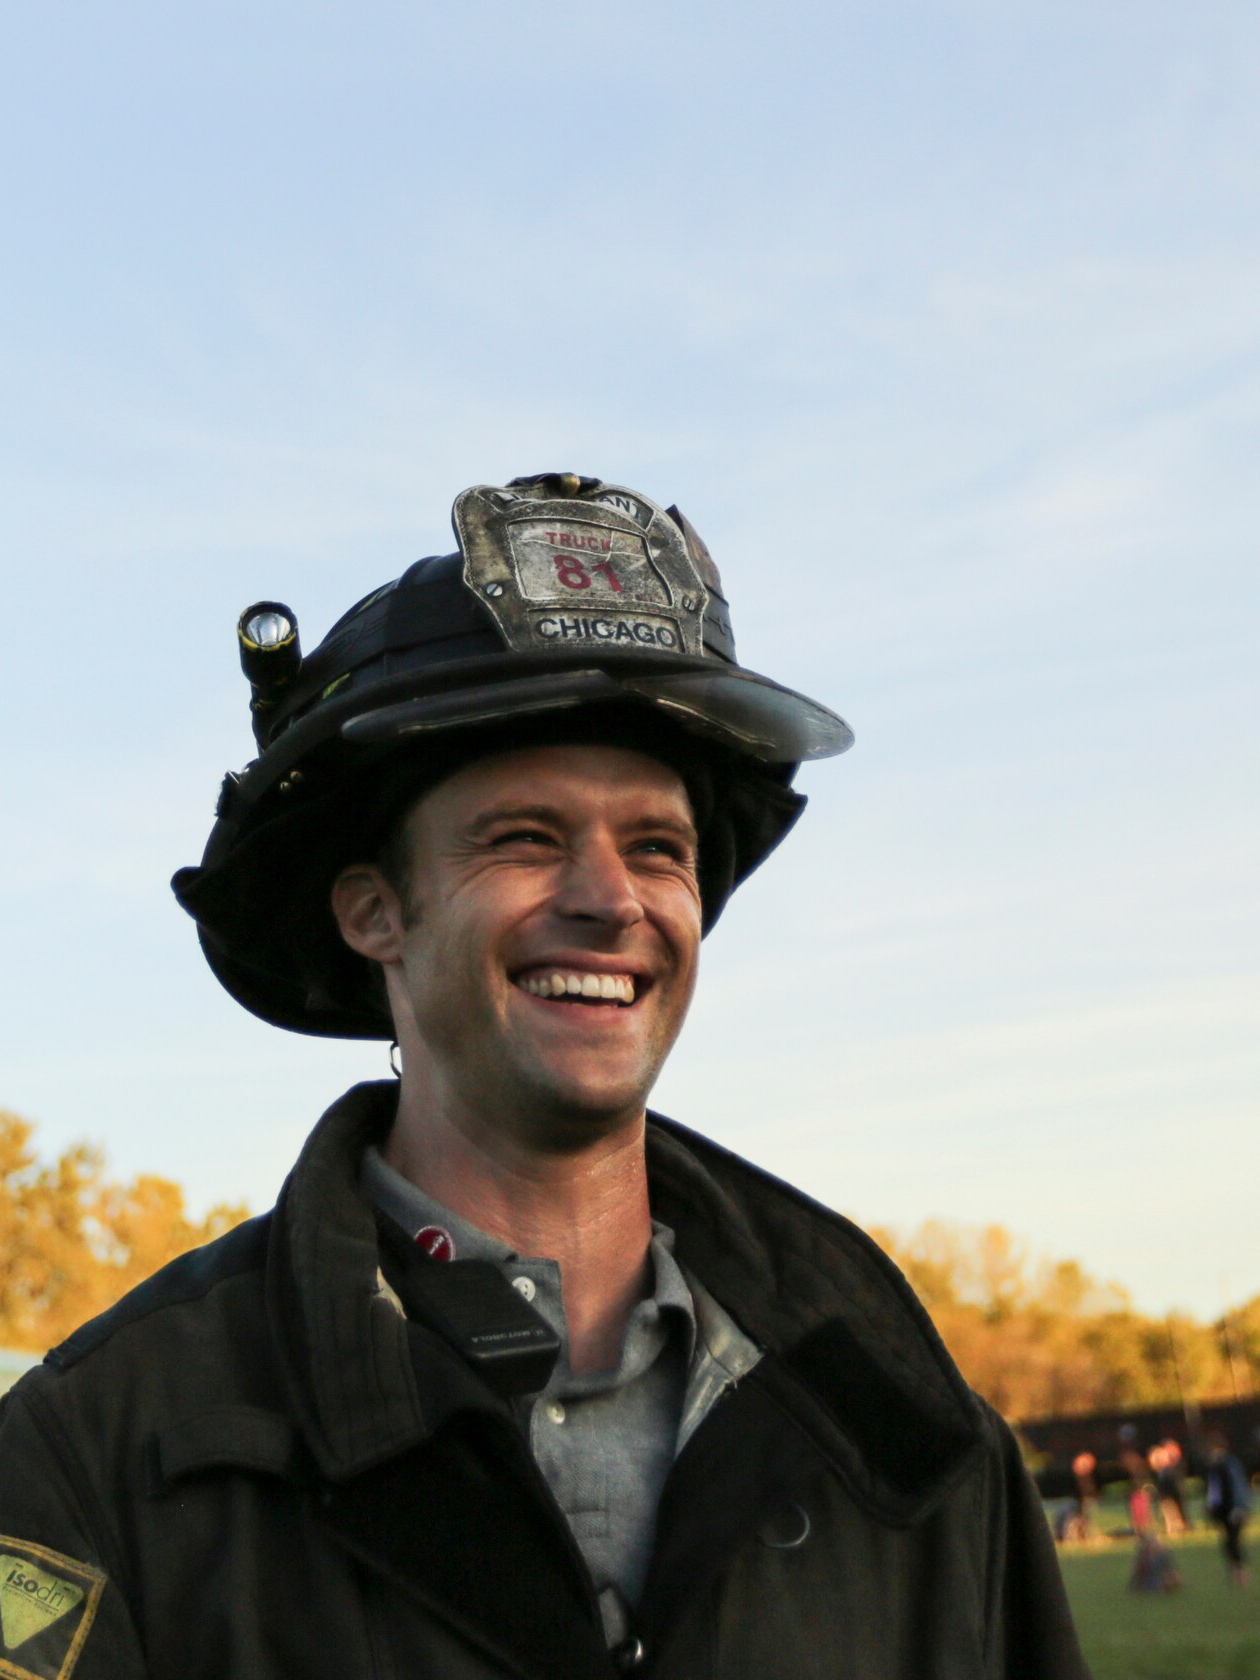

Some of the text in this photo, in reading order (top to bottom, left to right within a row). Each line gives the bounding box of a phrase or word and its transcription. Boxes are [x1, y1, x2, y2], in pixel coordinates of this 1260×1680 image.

[547, 532, 612, 551] TRUCK
[553, 553, 624, 593] 81
[537, 618, 677, 648] CHICAGO
